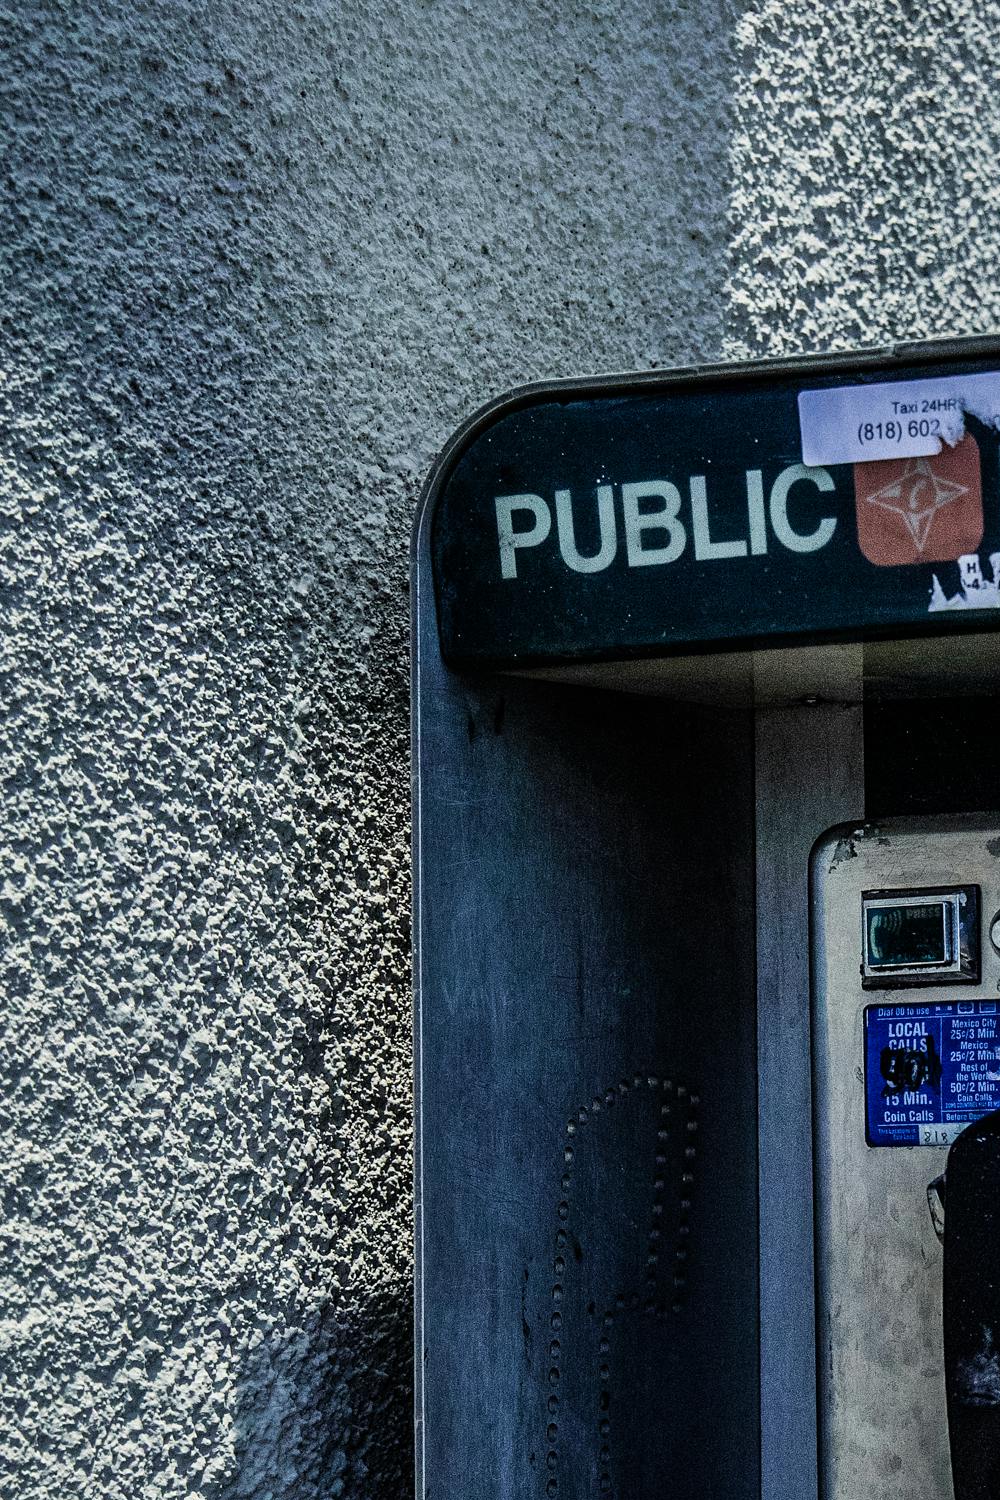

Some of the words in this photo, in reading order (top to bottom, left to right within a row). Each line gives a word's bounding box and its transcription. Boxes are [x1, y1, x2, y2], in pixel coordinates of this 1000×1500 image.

[891, 399, 918, 415] Taxi
[857, 421, 903, 445] (818)
[908, 420, 941, 438] 602
[494, 463, 838, 579] PUBLIC
[888, 1021, 928, 1037] LOCAL
[951, 1018, 980, 1029] Mexico
[981, 1017, 997, 1029] City
[977, 1027, 999, 1039] Min.
[960, 1040, 989, 1051] Mexico
[960, 1063, 979, 1072] Rest
[980, 1062, 988, 1072] of
[956, 1072, 968, 1082] the
[950, 1082, 976, 1094] 50¢/2
[977, 1080, 999, 1093] Min.
[903, 1091, 933, 1106] Min.
[957, 1093, 973, 1102] Coin
[975, 1092, 993, 1102] Calls
[884, 1110, 907, 1122] Coin
[908, 1109, 934, 1122] Calls
